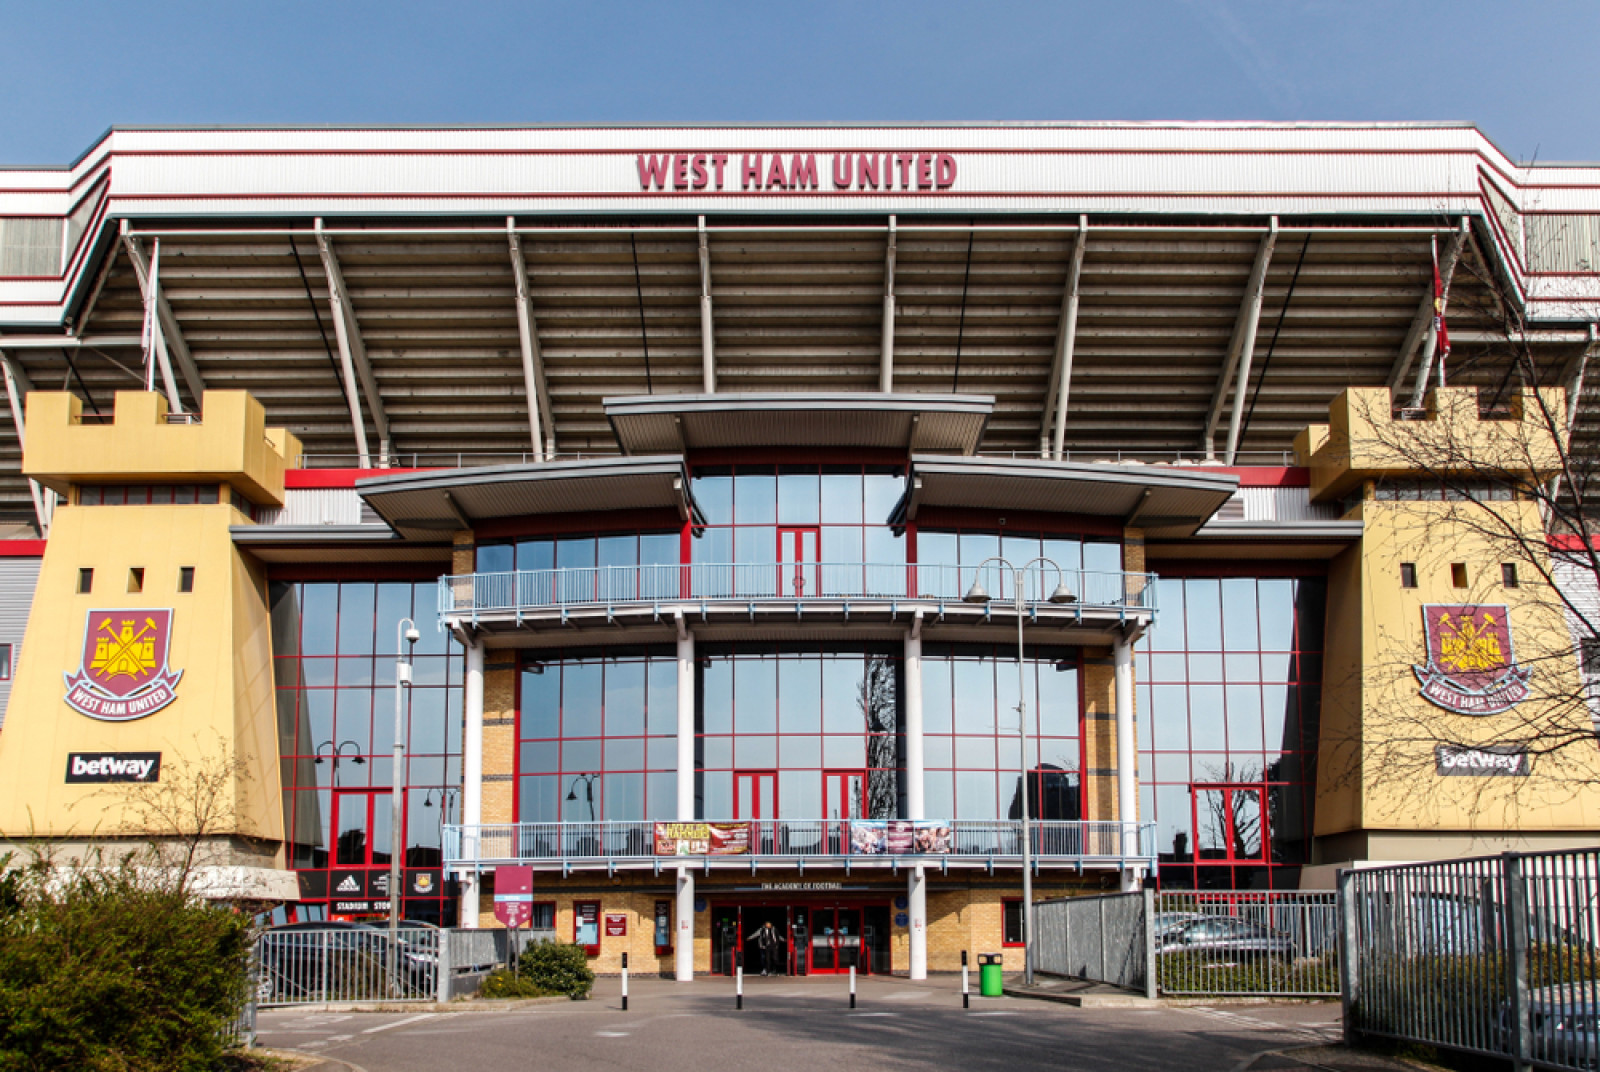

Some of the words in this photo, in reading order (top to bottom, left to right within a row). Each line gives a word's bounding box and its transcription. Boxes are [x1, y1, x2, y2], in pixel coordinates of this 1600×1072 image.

[637, 153, 728, 191] WEST
[743, 153, 818, 191] HAM
[833, 153, 957, 191] UNITED
[72, 688, 101, 711] WEST
[101, 702, 126, 715] HAM
[129, 690, 167, 713] UNITED
[1430, 682, 1457, 705] WEST
[72, 756, 154, 779] betway
[1441, 748, 1521, 773] betway
[773, 882, 802, 891] ACADEMY
[337, 902, 368, 910] STADIUM
[374, 902, 391, 910] STOR
